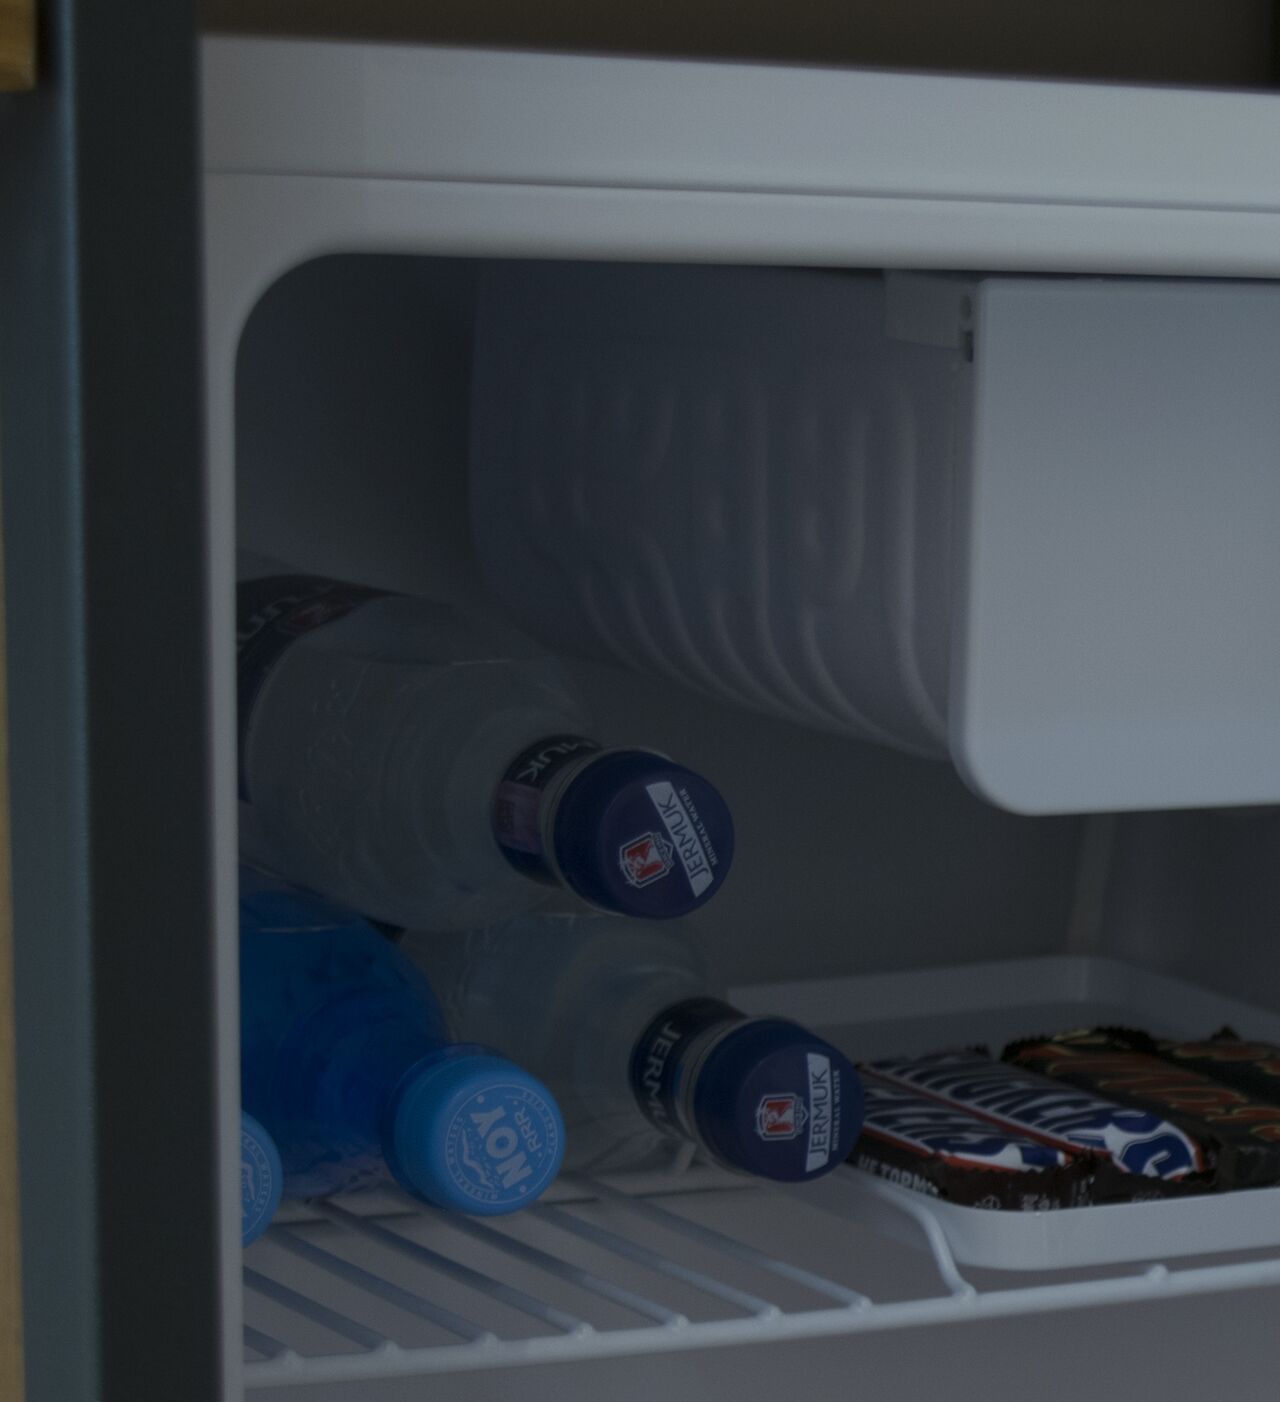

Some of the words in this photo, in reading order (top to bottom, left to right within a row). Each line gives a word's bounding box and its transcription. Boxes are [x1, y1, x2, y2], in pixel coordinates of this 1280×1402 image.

[658, 792, 710, 882] JERMUK
[642, 1020, 682, 1138] JERMU
[809, 1068, 829, 1156] JERMUK
[469, 1104, 534, 1189] NOY
